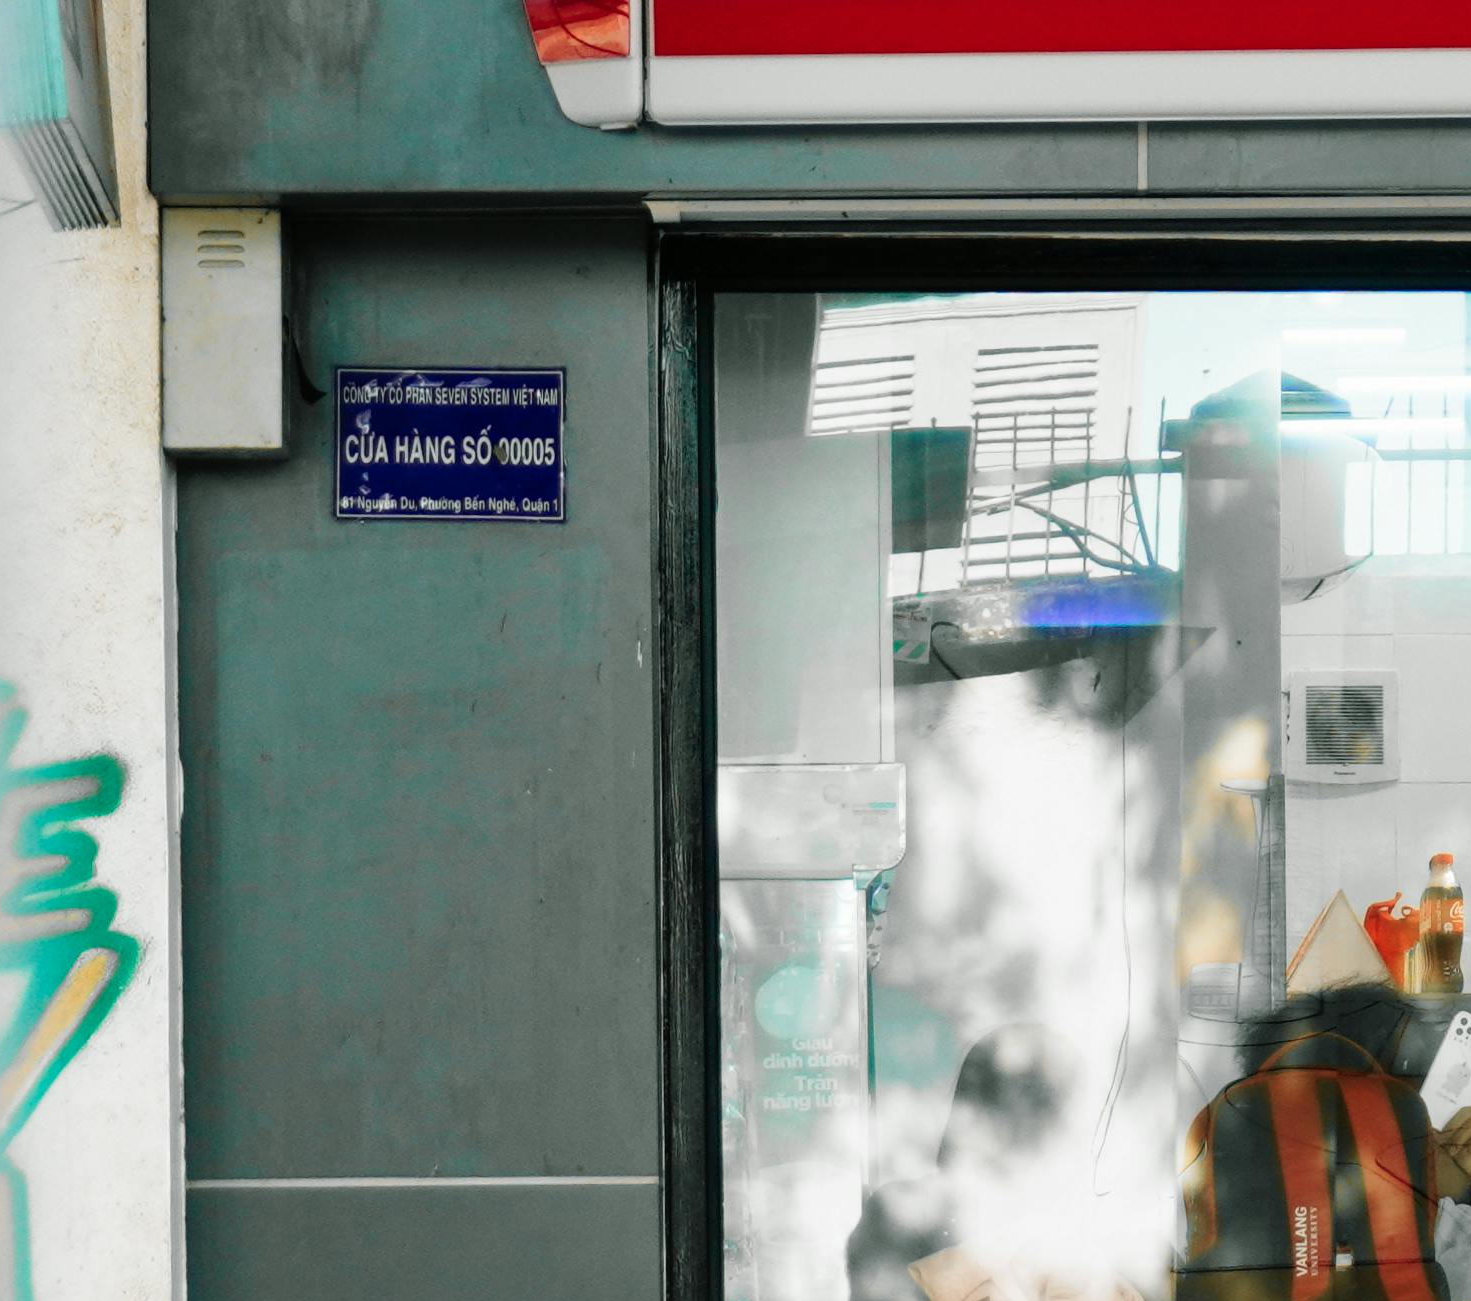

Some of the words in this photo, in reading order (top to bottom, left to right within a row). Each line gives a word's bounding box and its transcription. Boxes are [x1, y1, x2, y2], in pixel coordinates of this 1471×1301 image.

[343, 382, 370, 405] CÔNG
[435, 387, 468, 405] SEVEN
[470, 387, 510, 406] SYSTEM
[513, 383, 534, 408] VIỆT
[536, 388, 558, 406] NAM
[345, 431, 389, 464] CỬA
[395, 427, 456, 464] HÀNG
[462, 425, 492, 465] SỐ
[464, 494, 486, 511] Bến
[488, 497, 520, 513] Nghé,
[522, 498, 550, 514] Quận
[553, 499, 559, 511] 1
[1294, 1205, 1309, 1278] VANLANG
[1310, 1206, 1319, 1277] UNIVERSITY
